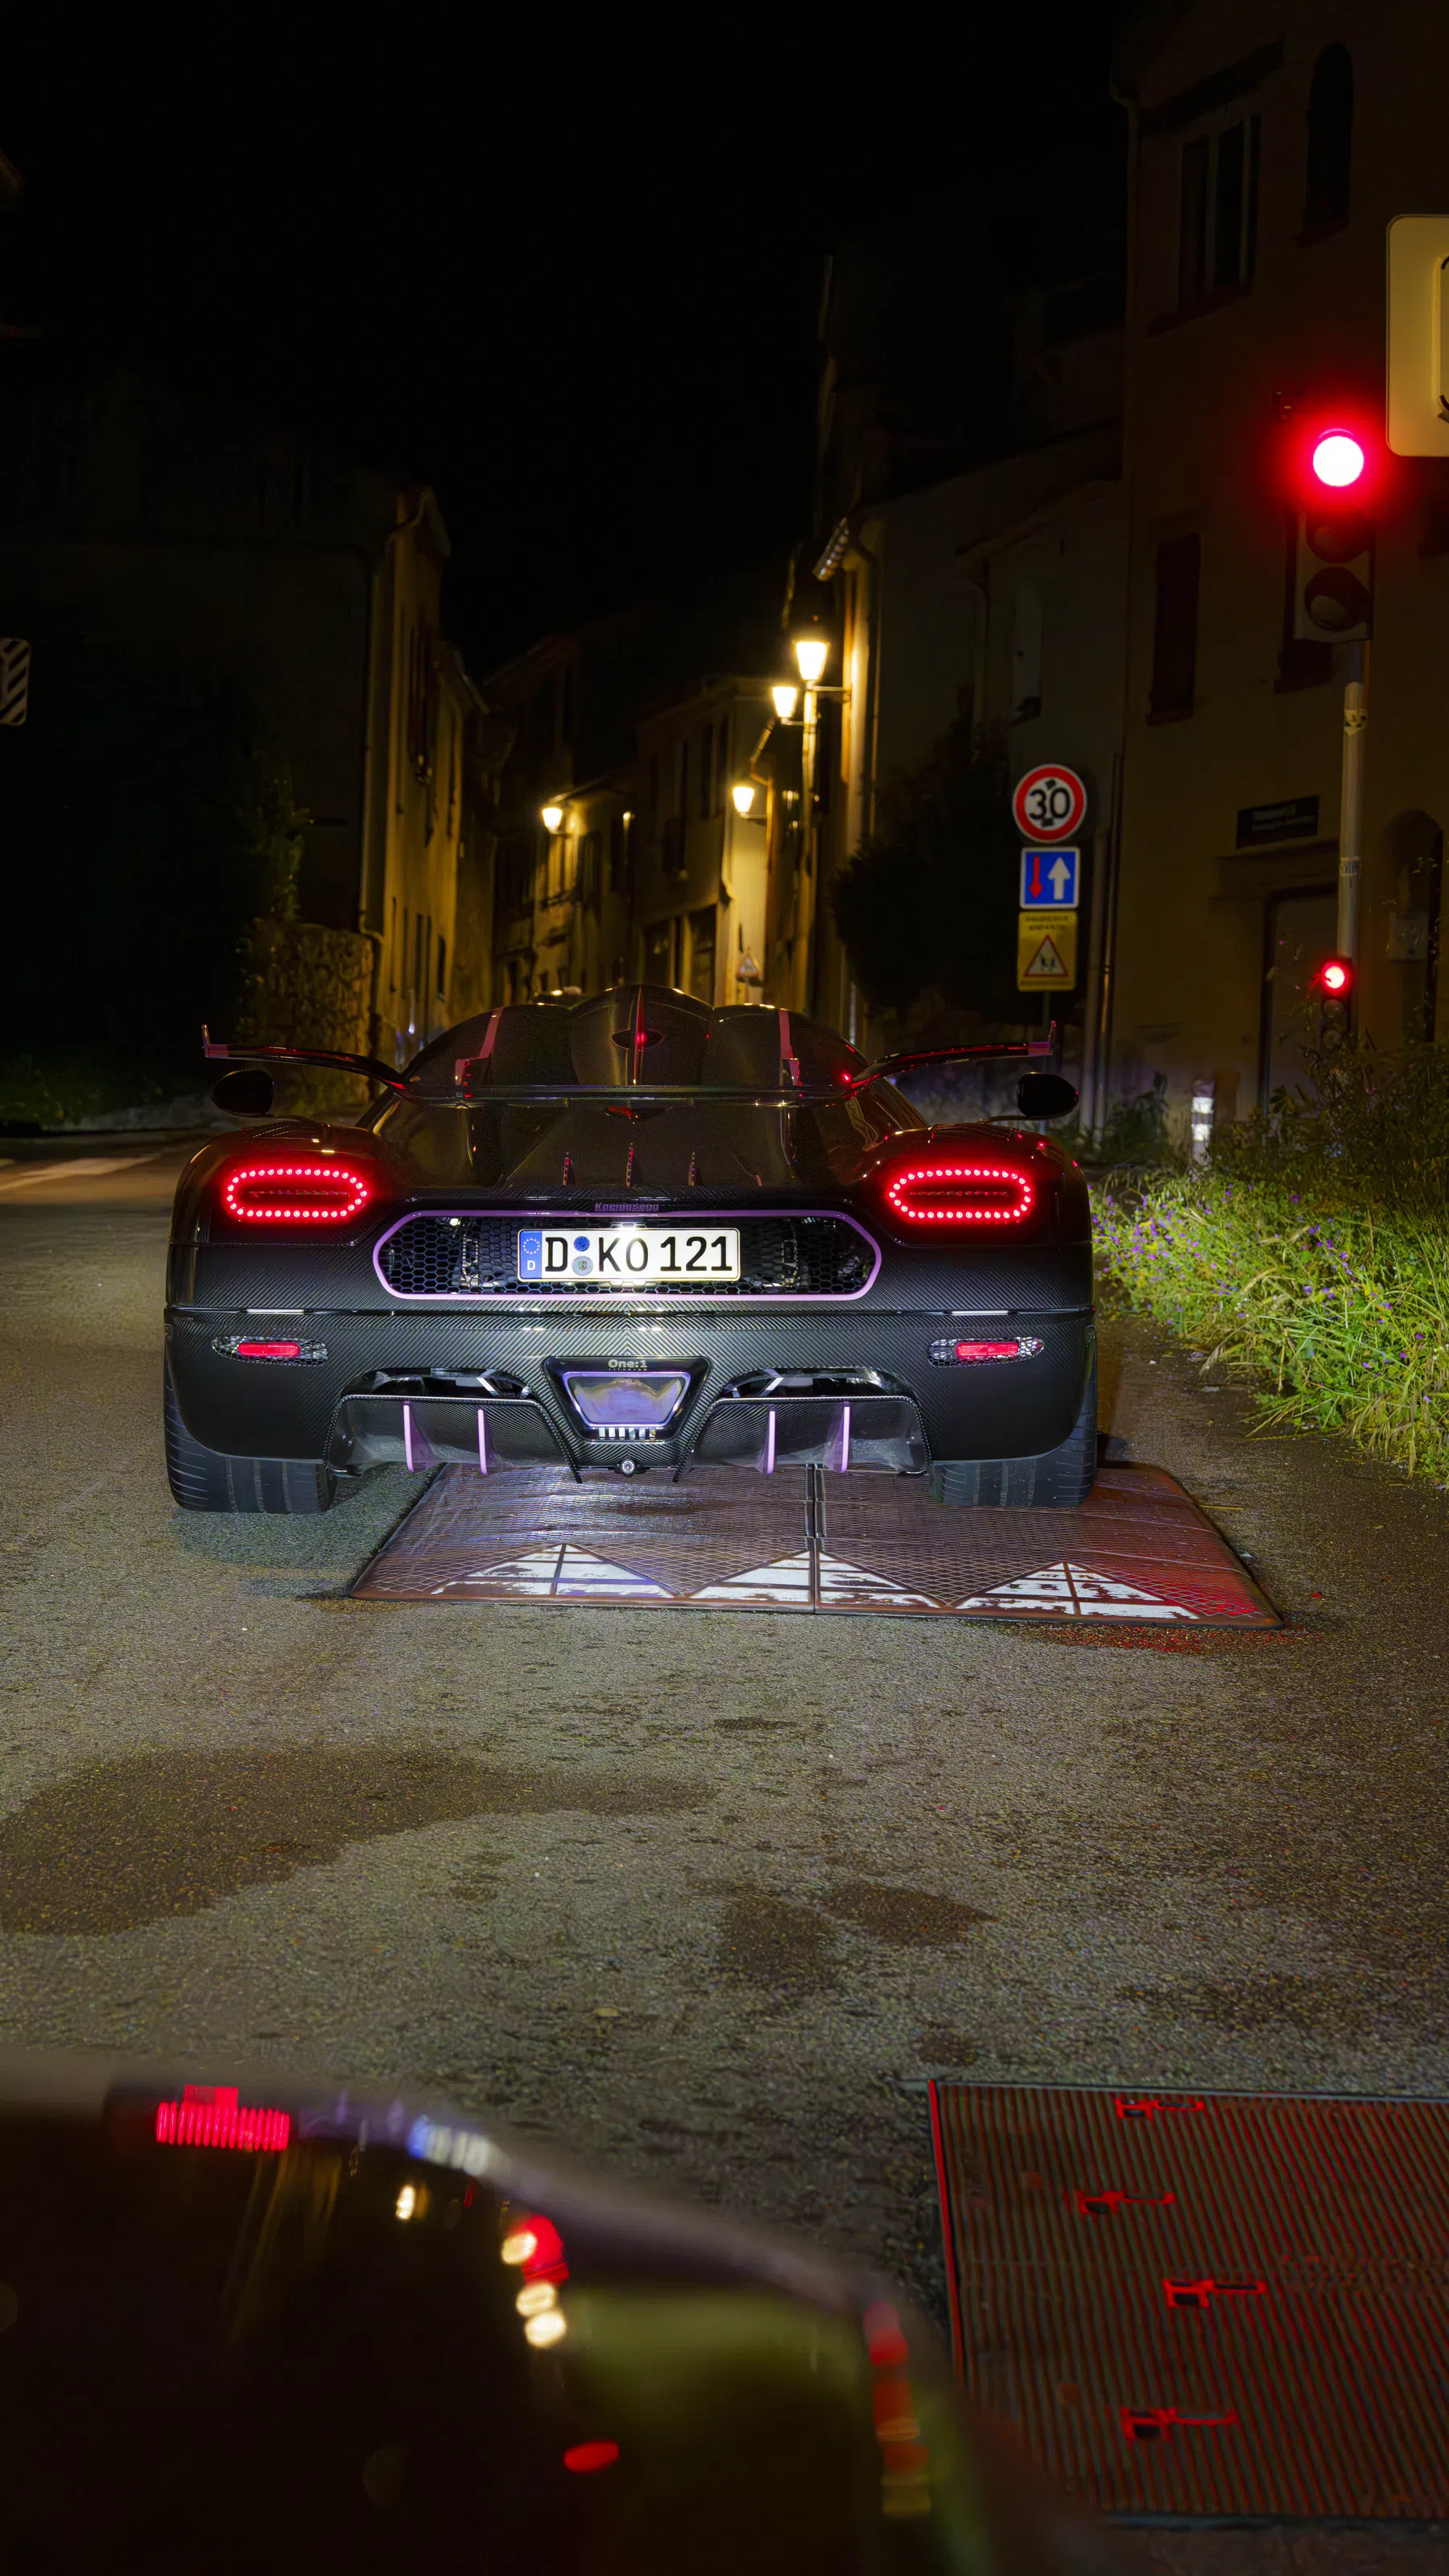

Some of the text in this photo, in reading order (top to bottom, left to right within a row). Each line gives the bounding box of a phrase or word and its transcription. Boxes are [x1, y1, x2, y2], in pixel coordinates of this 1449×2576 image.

[1030, 788, 1070, 819] 30
[594, 1202, 659, 1212] Koenigsegg
[545, 1236, 733, 1272] D KO 121
[526, 1260, 536, 1271] D
[608, 1358, 648, 1368] One:1
